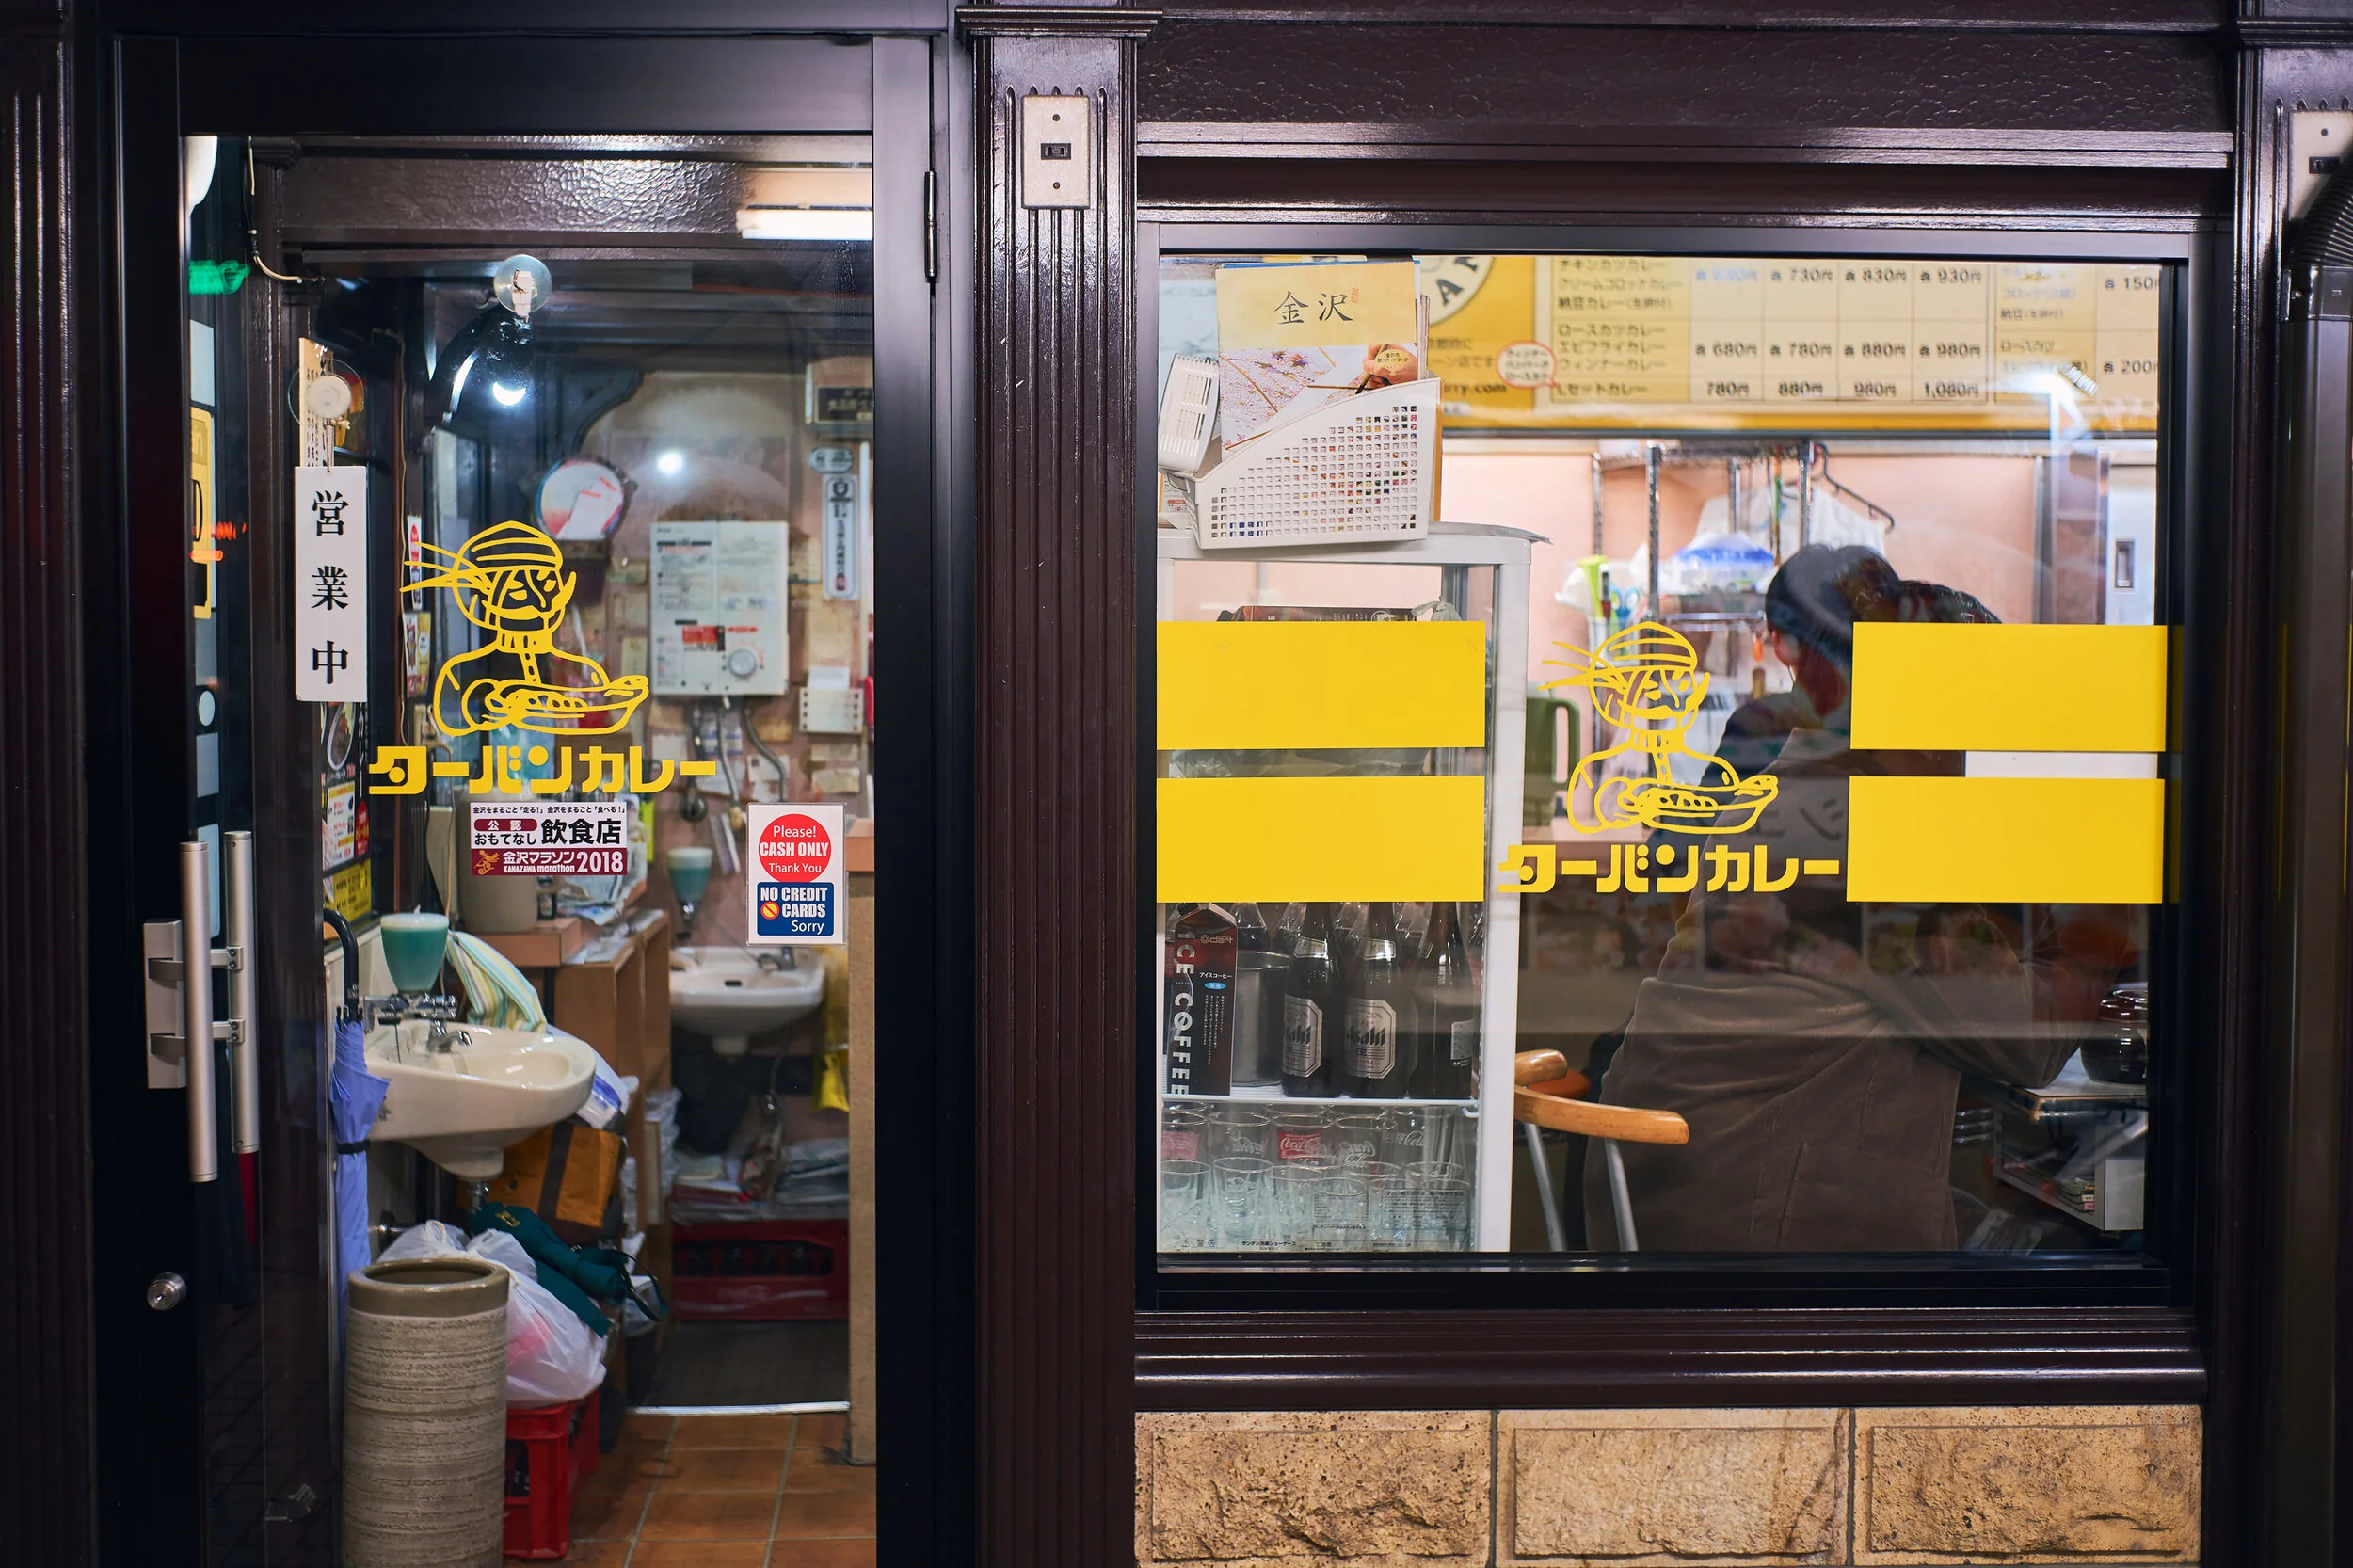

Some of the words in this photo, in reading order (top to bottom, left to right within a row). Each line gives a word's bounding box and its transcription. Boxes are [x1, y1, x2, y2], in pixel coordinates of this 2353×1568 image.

[1273, 290, 1353, 325] 金沢
[312, 490, 349, 685] 営業中
[368, 745, 716, 795] ターバンカレー
[540, 818, 622, 844] 飲食店
[773, 825, 816, 838] Please!
[474, 833, 536, 845] おもてなし
[760, 842, 794, 856] CASH
[797, 842, 829, 856] ONLY
[503, 851, 575, 864] 金沢マラソン
[576, 851, 624, 872] 2018
[504, 865, 536, 873] KANAZAWA
[536, 864, 575, 873] marathon
[768, 862, 800, 872] Thank
[802, 863, 822, 872] You
[1498, 844, 1839, 892] ターバンカレー
[760, 887, 778, 901] NO
[781, 887, 827, 902] CREDIT
[781, 903, 826, 918] CARDS
[791, 920, 824, 935] Sorry
[1199, 971, 1233, 980] アイスコーヒー
